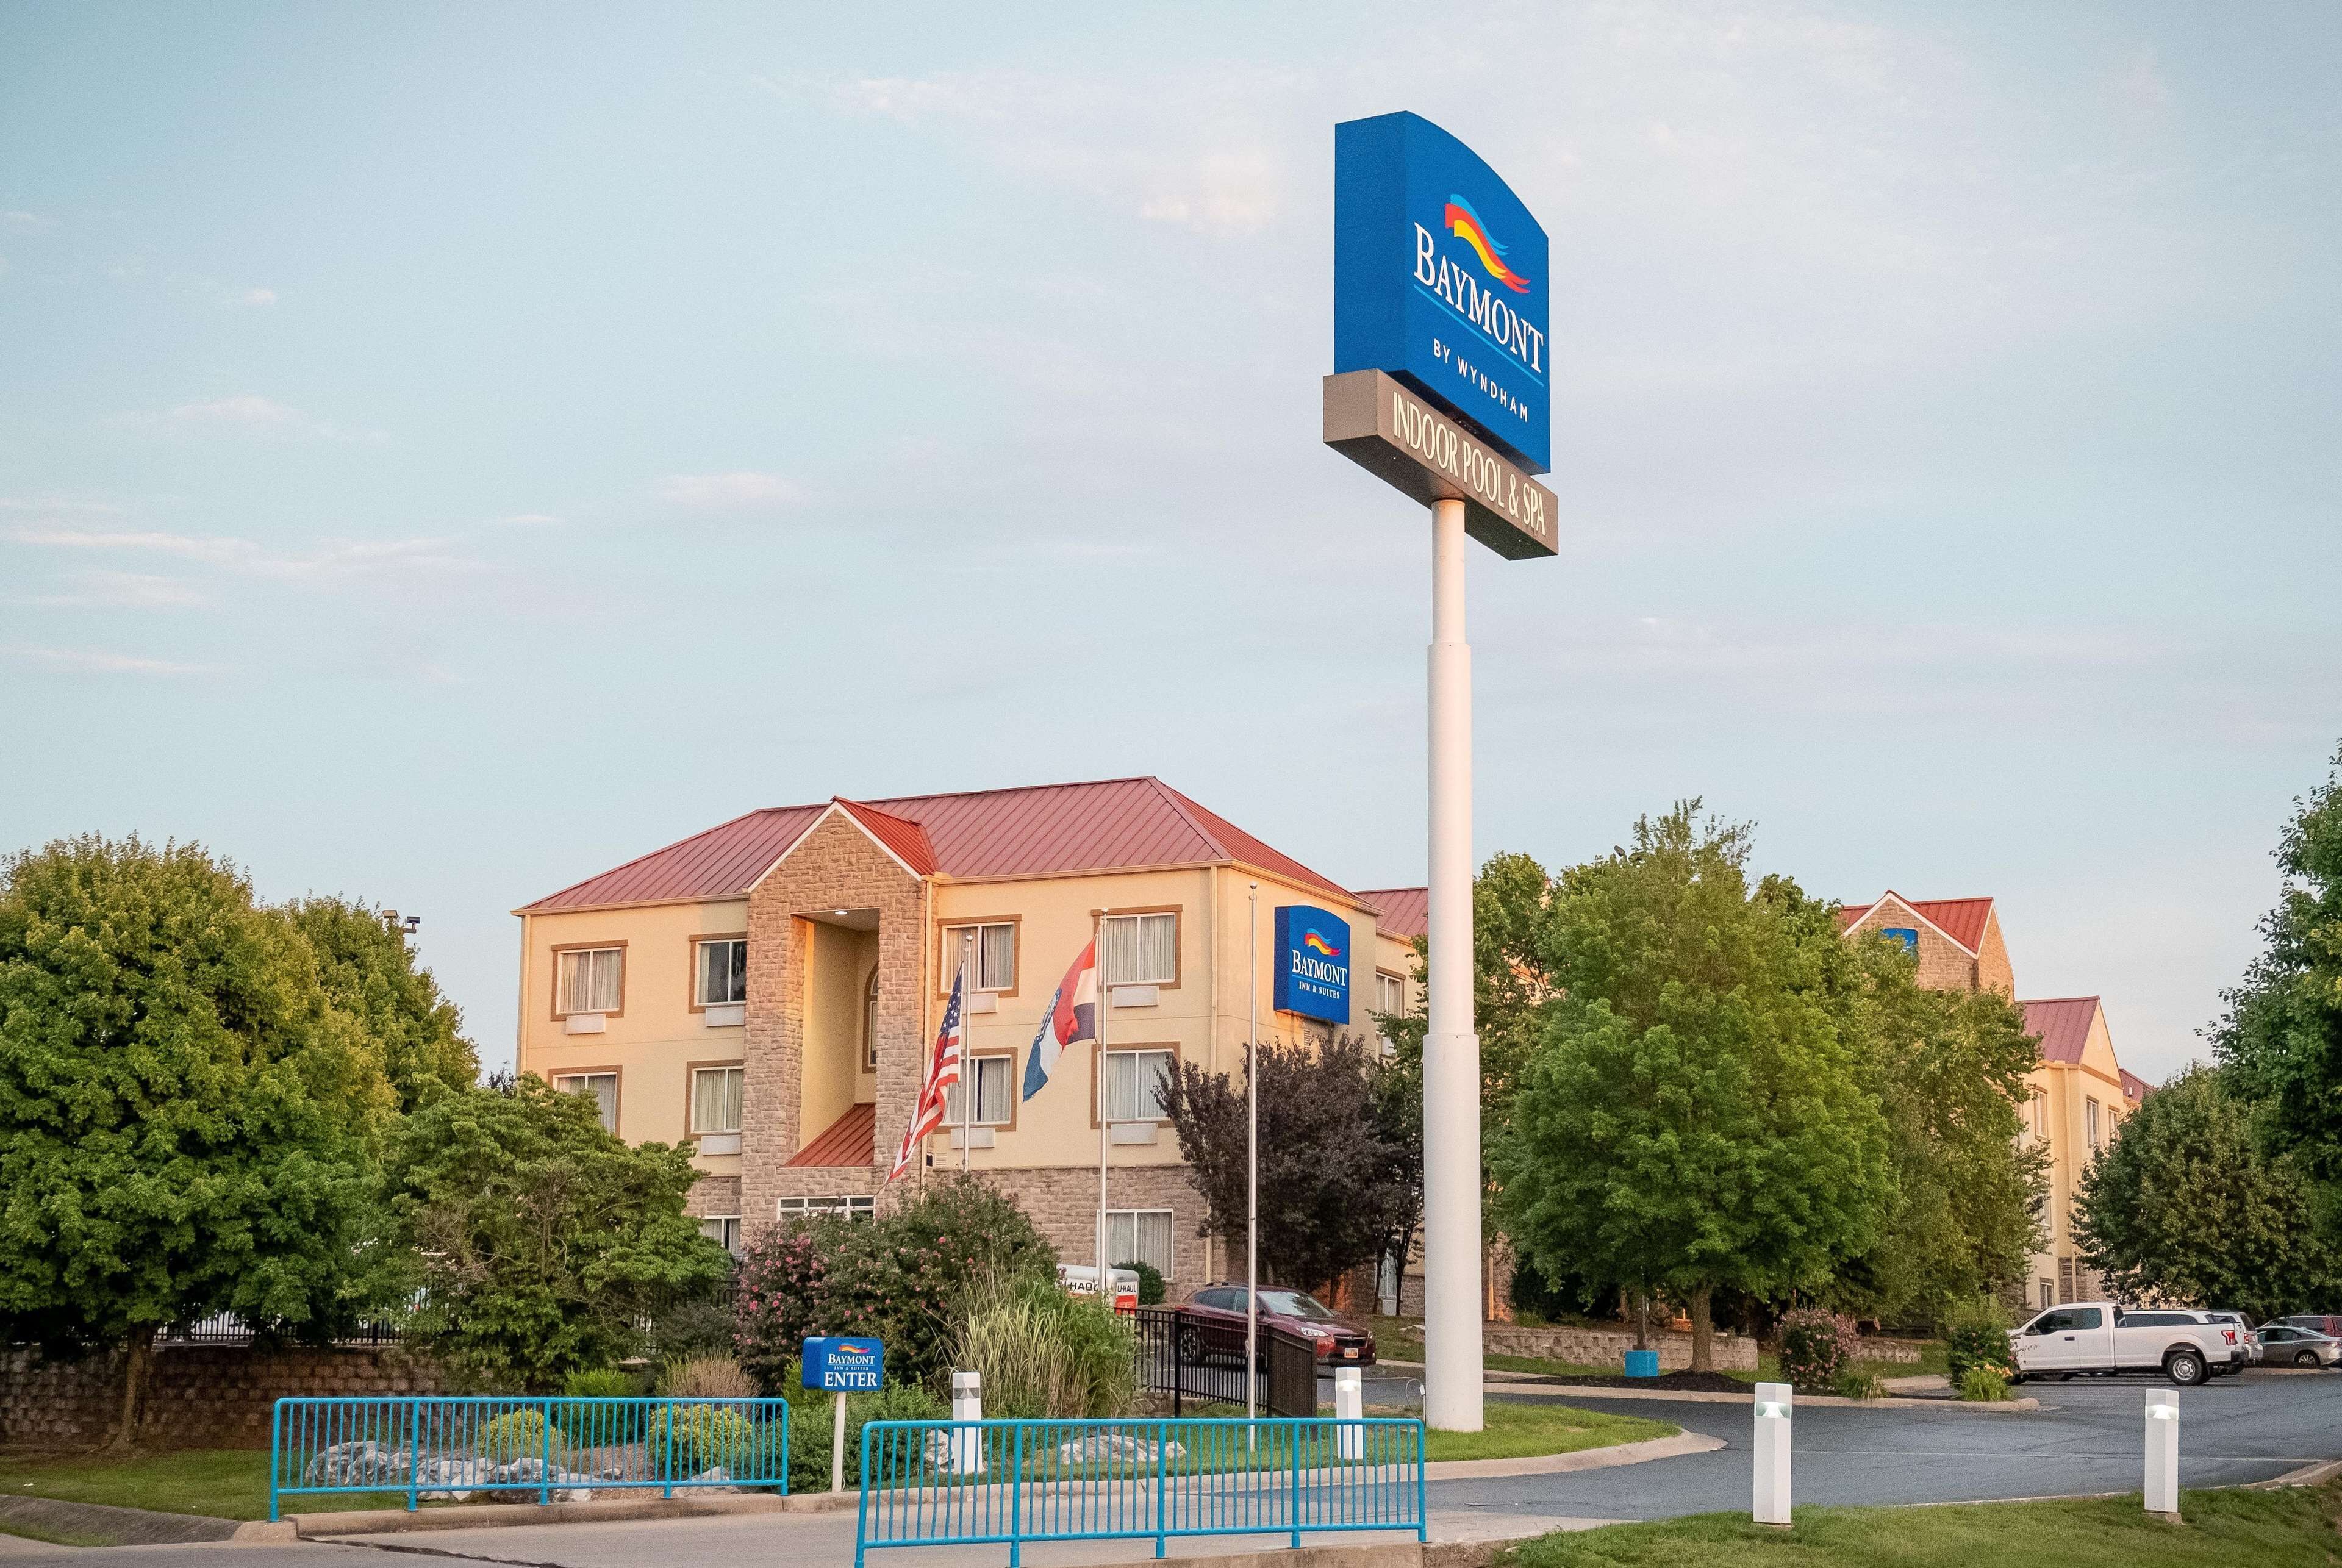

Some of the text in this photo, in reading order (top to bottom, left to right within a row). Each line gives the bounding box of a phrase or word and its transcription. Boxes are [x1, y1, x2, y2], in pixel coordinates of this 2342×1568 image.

[1413, 221, 1544, 374] BAYMONT
[1433, 338, 1528, 423] BY WYNDHAM
[1393, 391, 1546, 537] INDOOR POOL & SPA
[1291, 949, 1347, 986] BAYMONT
[1299, 981, 1340, 999] INN & SUITES
[828, 1353, 875, 1364] BAYMONT
[825, 1372, 877, 1387] ENTER
